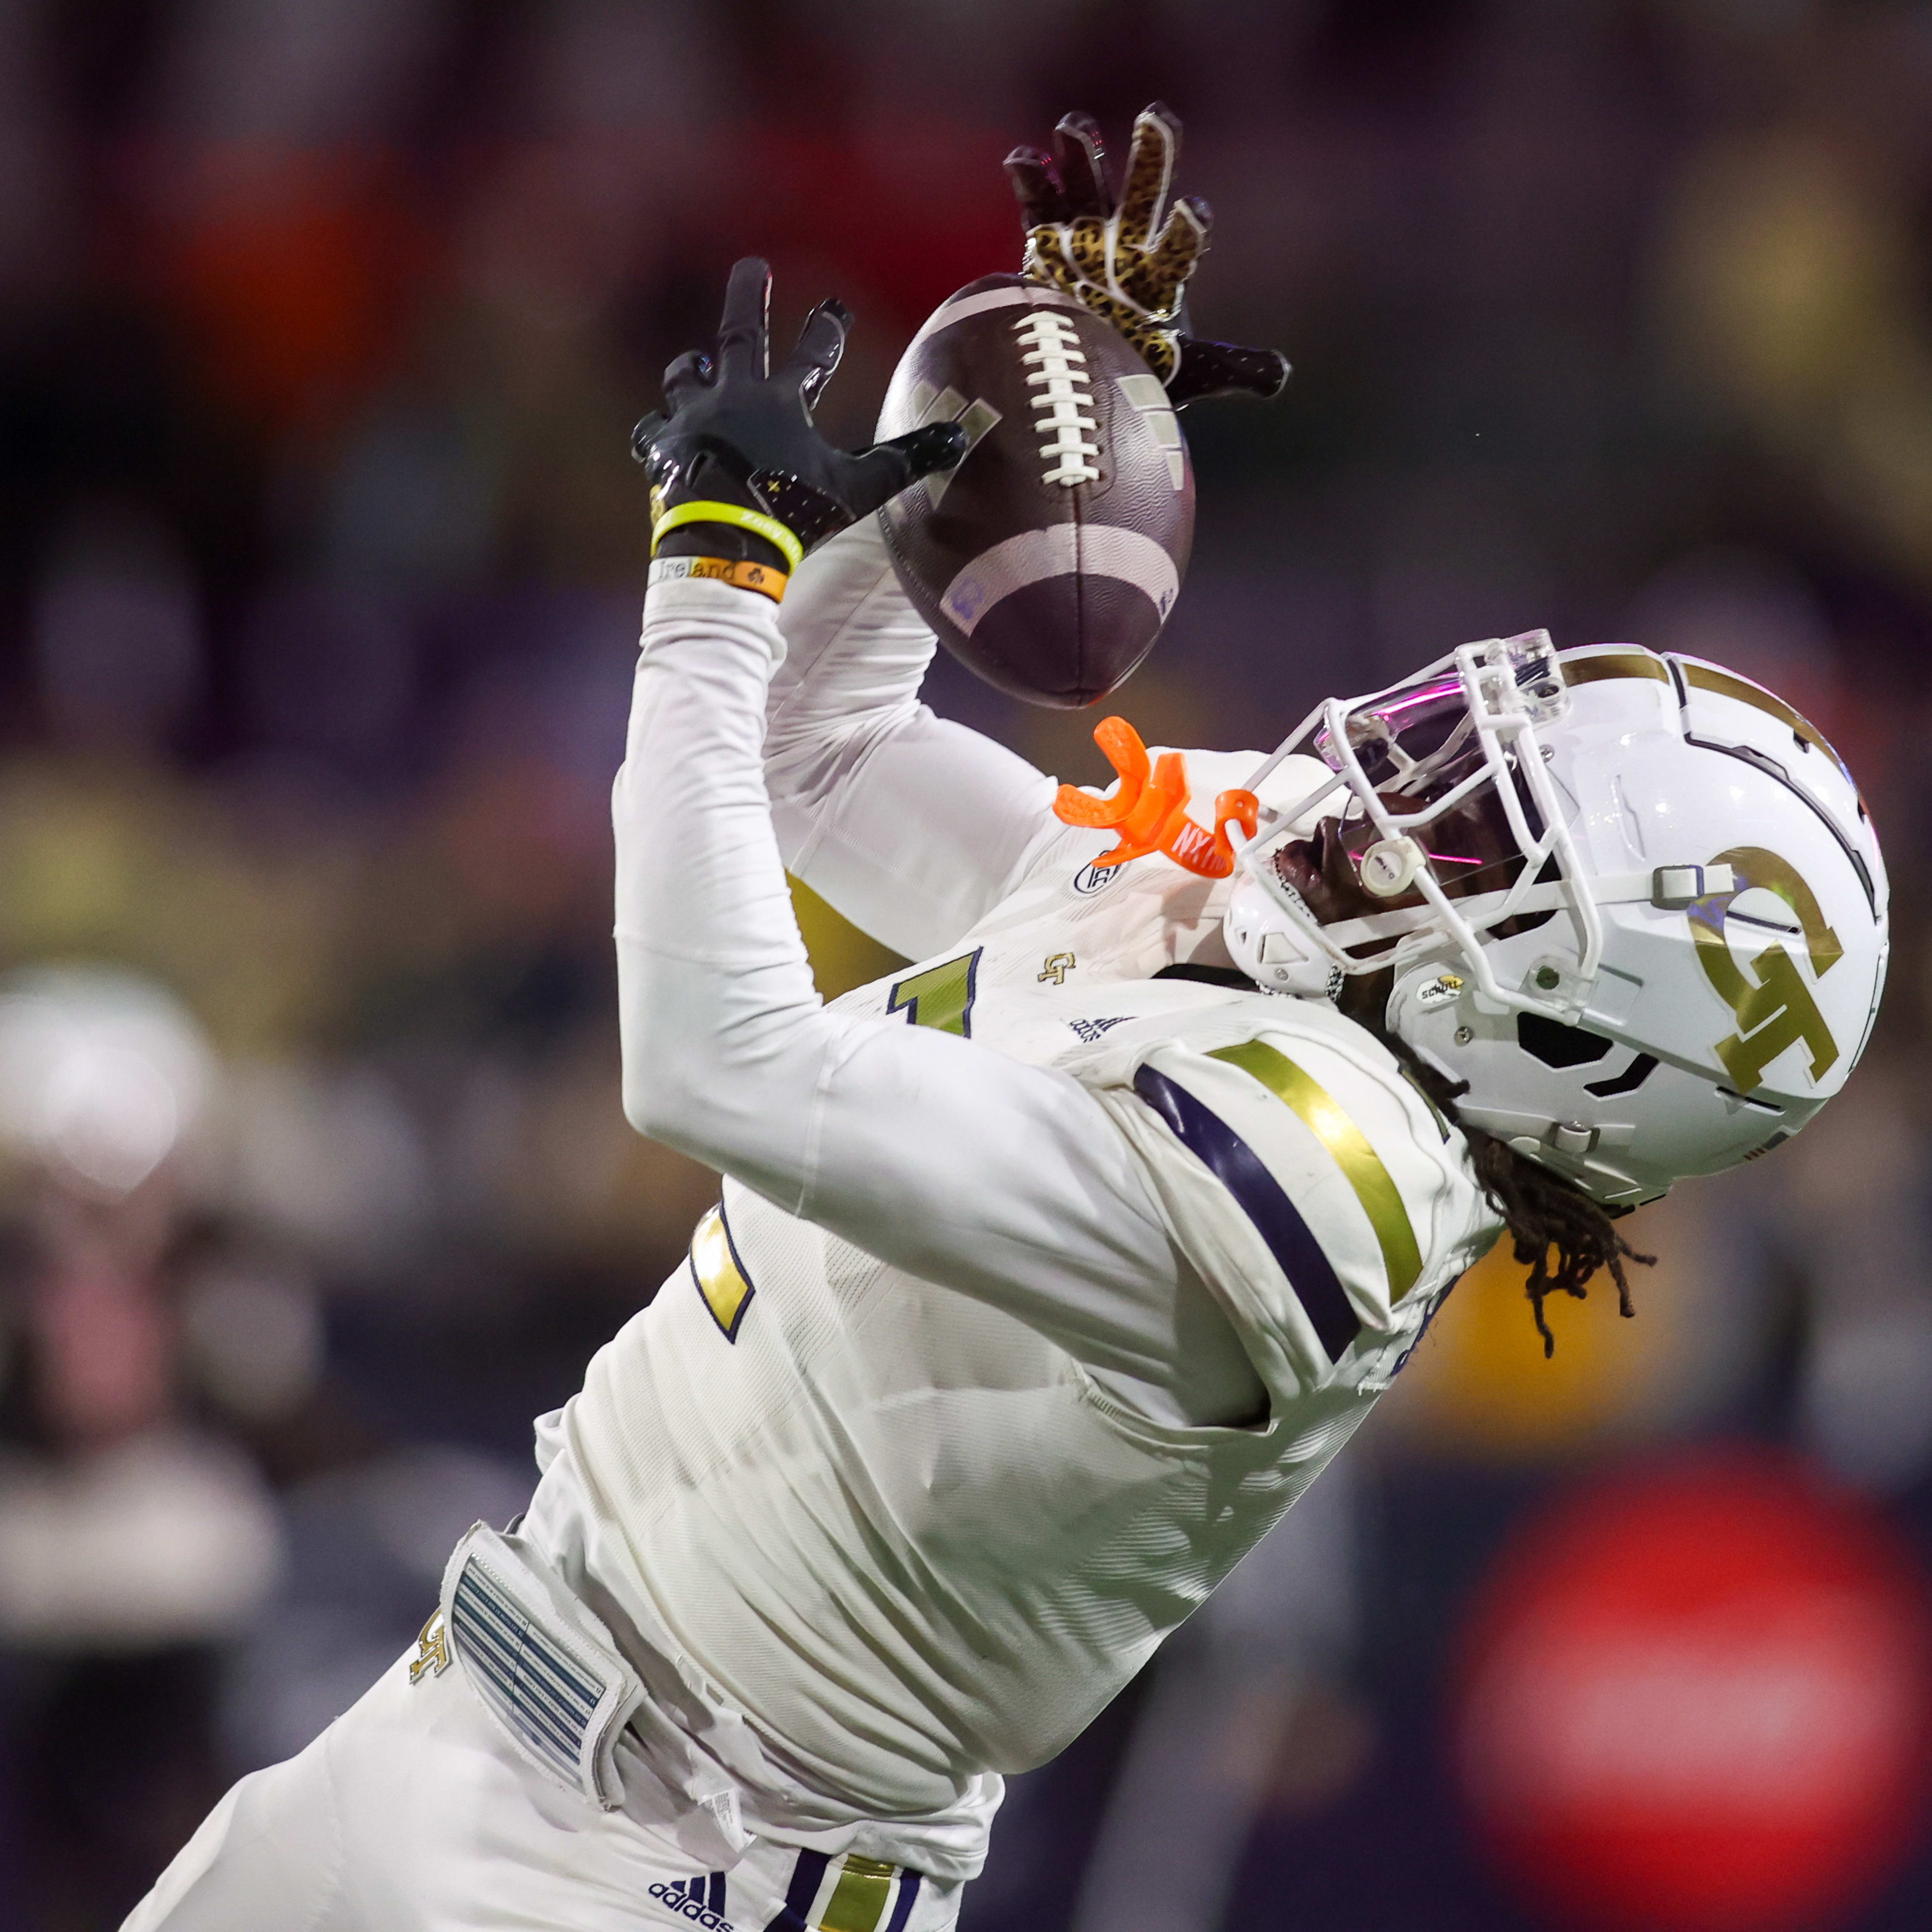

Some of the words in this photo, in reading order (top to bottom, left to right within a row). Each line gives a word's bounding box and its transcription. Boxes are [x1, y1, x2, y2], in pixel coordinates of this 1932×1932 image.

[659, 560, 736, 579] Ireland
[1037, 952, 1076, 985] GT
[1687, 846, 1844, 1094] GT
